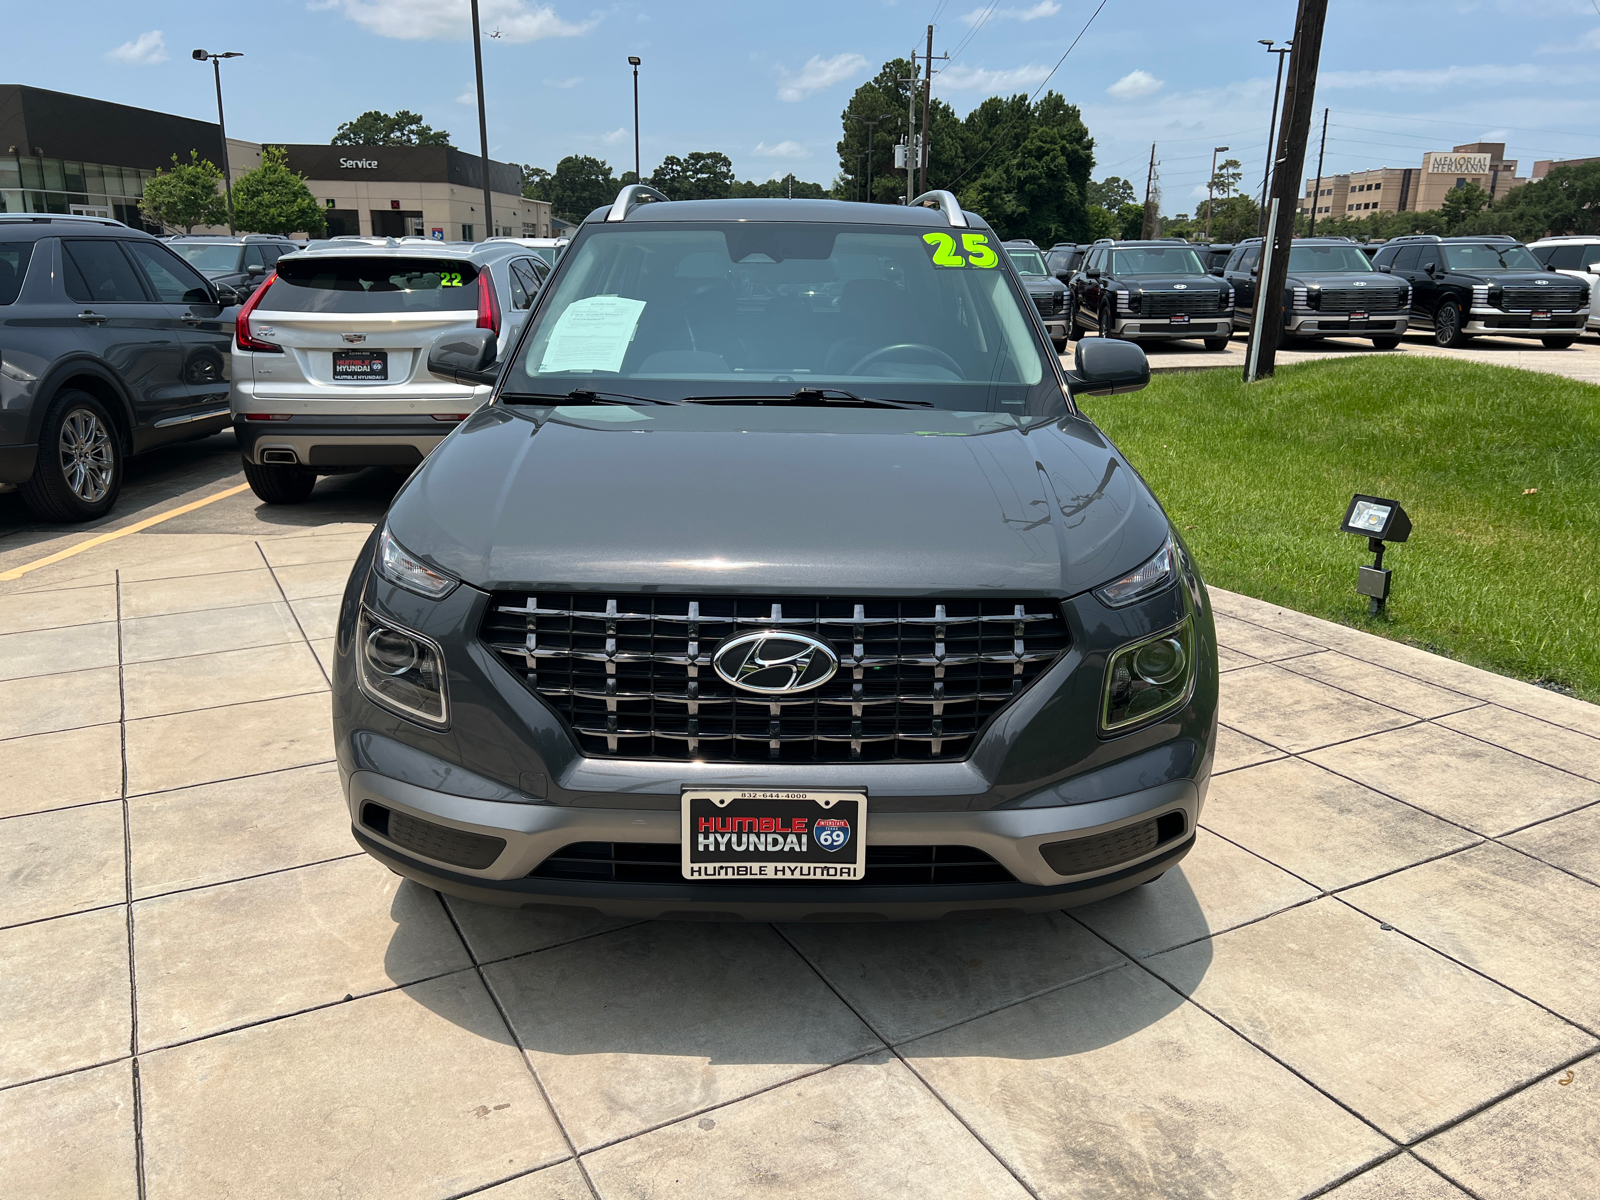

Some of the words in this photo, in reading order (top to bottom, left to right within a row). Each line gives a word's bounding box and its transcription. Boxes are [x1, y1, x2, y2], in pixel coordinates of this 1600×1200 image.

[339, 157, 378, 169] Service
[1432, 164, 1487, 173] HERMANN
[1433, 156, 1488, 166] MEMORIAL
[922, 232, 999, 269] 25
[440, 272, 463, 287] 22
[698, 816, 808, 833] HUMBLE
[698, 833, 808, 852] HYUNDAI
[819, 830, 845, 846] 69
[690, 865, 768, 877] HUMBLE
[774, 865, 857, 878] HYUNDAI
